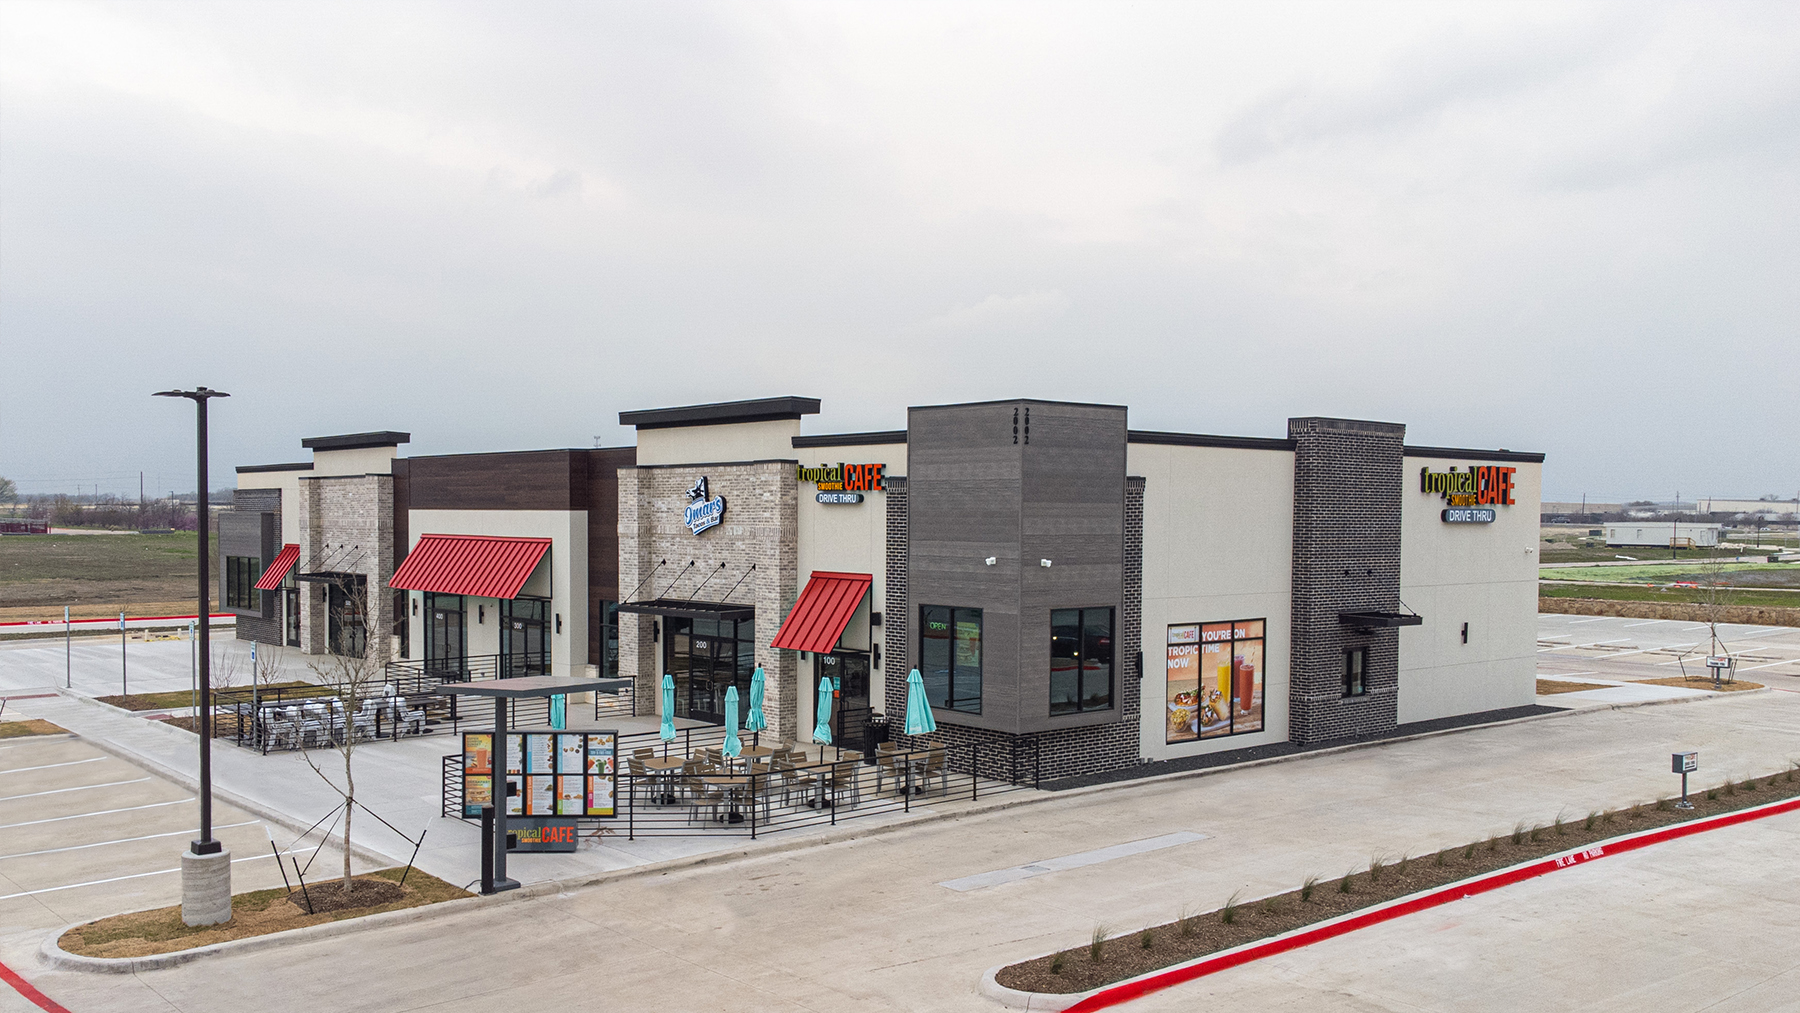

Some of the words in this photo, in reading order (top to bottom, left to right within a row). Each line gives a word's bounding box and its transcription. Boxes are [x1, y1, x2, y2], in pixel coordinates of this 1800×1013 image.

[797, 462, 842, 484] tropical
[844, 463, 883, 491] CAFE
[1424, 466, 1477, 499] tropical
[1478, 466, 1516, 505] CAFE
[819, 494, 838, 503] DRIVE
[839, 494, 857, 503] THRU
[1449, 510, 1471, 522] DRIVE
[1472, 510, 1492, 522] THRU
[929, 621, 947, 631] OPEN
[1202, 629, 1232, 642] YOU'RE
[1234, 628, 1246, 639] ON
[696, 640, 707, 649] 200
[1168, 645, 1199, 657] TROPIC
[1202, 643, 1220, 654] TIME
[823, 656, 836, 665] 100
[1168, 658, 1190, 669] NOW
[542, 826, 574, 843] CAFE
